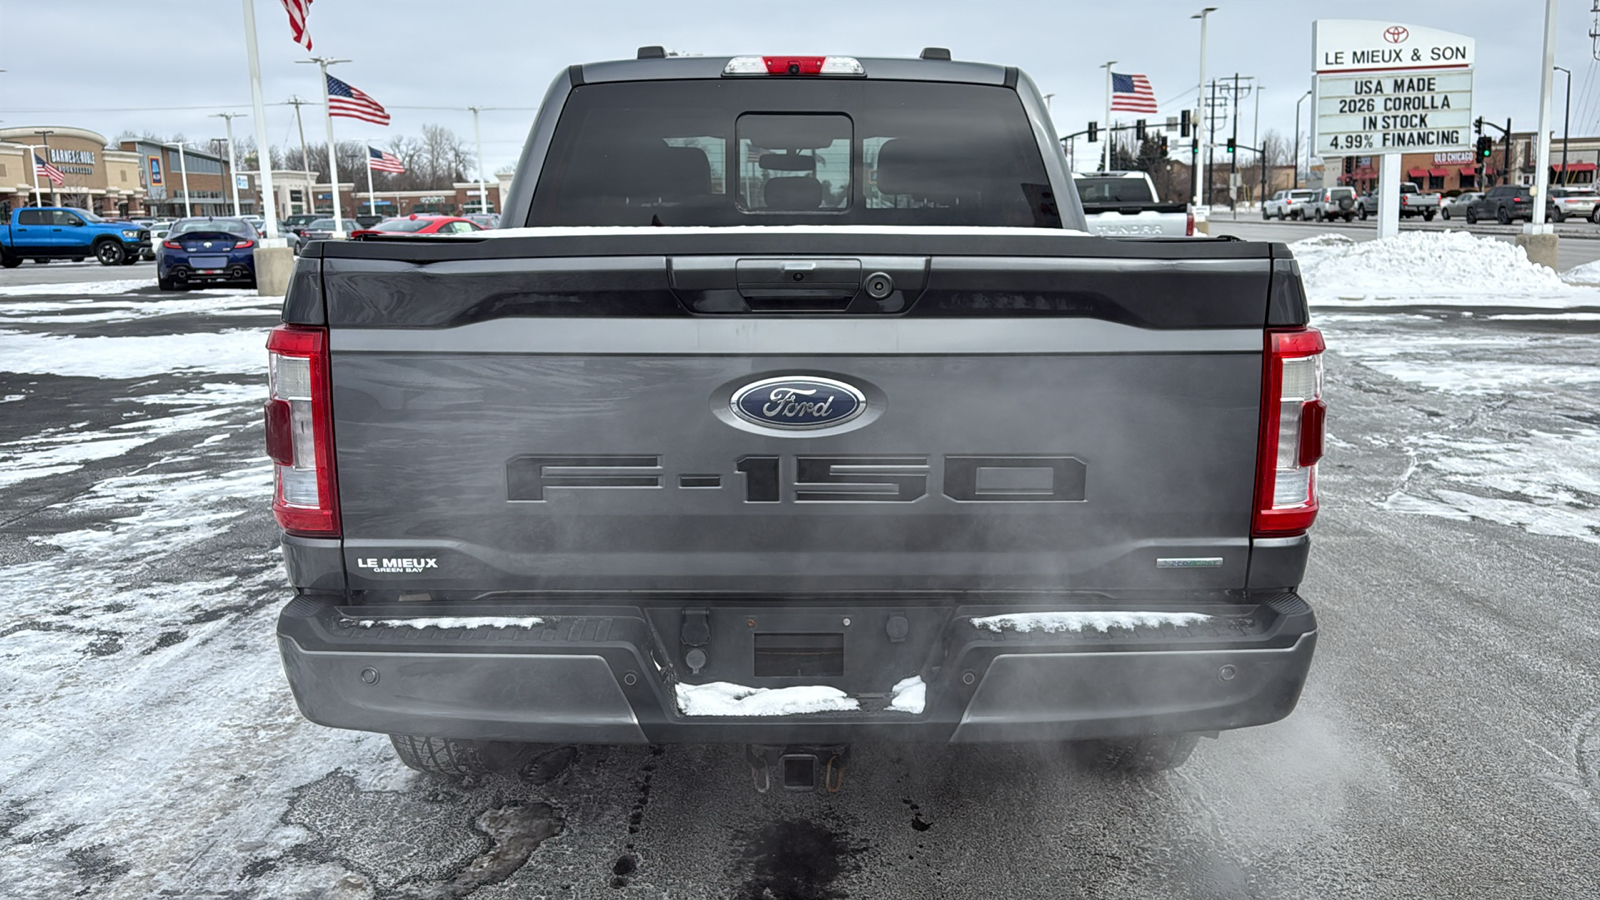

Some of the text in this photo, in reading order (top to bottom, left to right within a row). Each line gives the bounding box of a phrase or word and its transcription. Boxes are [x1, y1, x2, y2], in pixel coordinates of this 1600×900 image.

[1325, 46, 1467, 65] LE MIEUX & SON
[1354, 77, 1436, 95] USA MADE
[1339, 94, 1451, 114] 2026 COROLLA
[1362, 113, 1428, 131] IN STOCK
[1330, 130, 1460, 149] 4.99% FINANCING
[1447, 152, 1473, 162] CHICAGO
[1096, 225, 1163, 235] TUNDRA
[762, 387, 834, 417] Ford
[506, 453, 1088, 504] F-150
[357, 558, 439, 568] LE MIEUX
